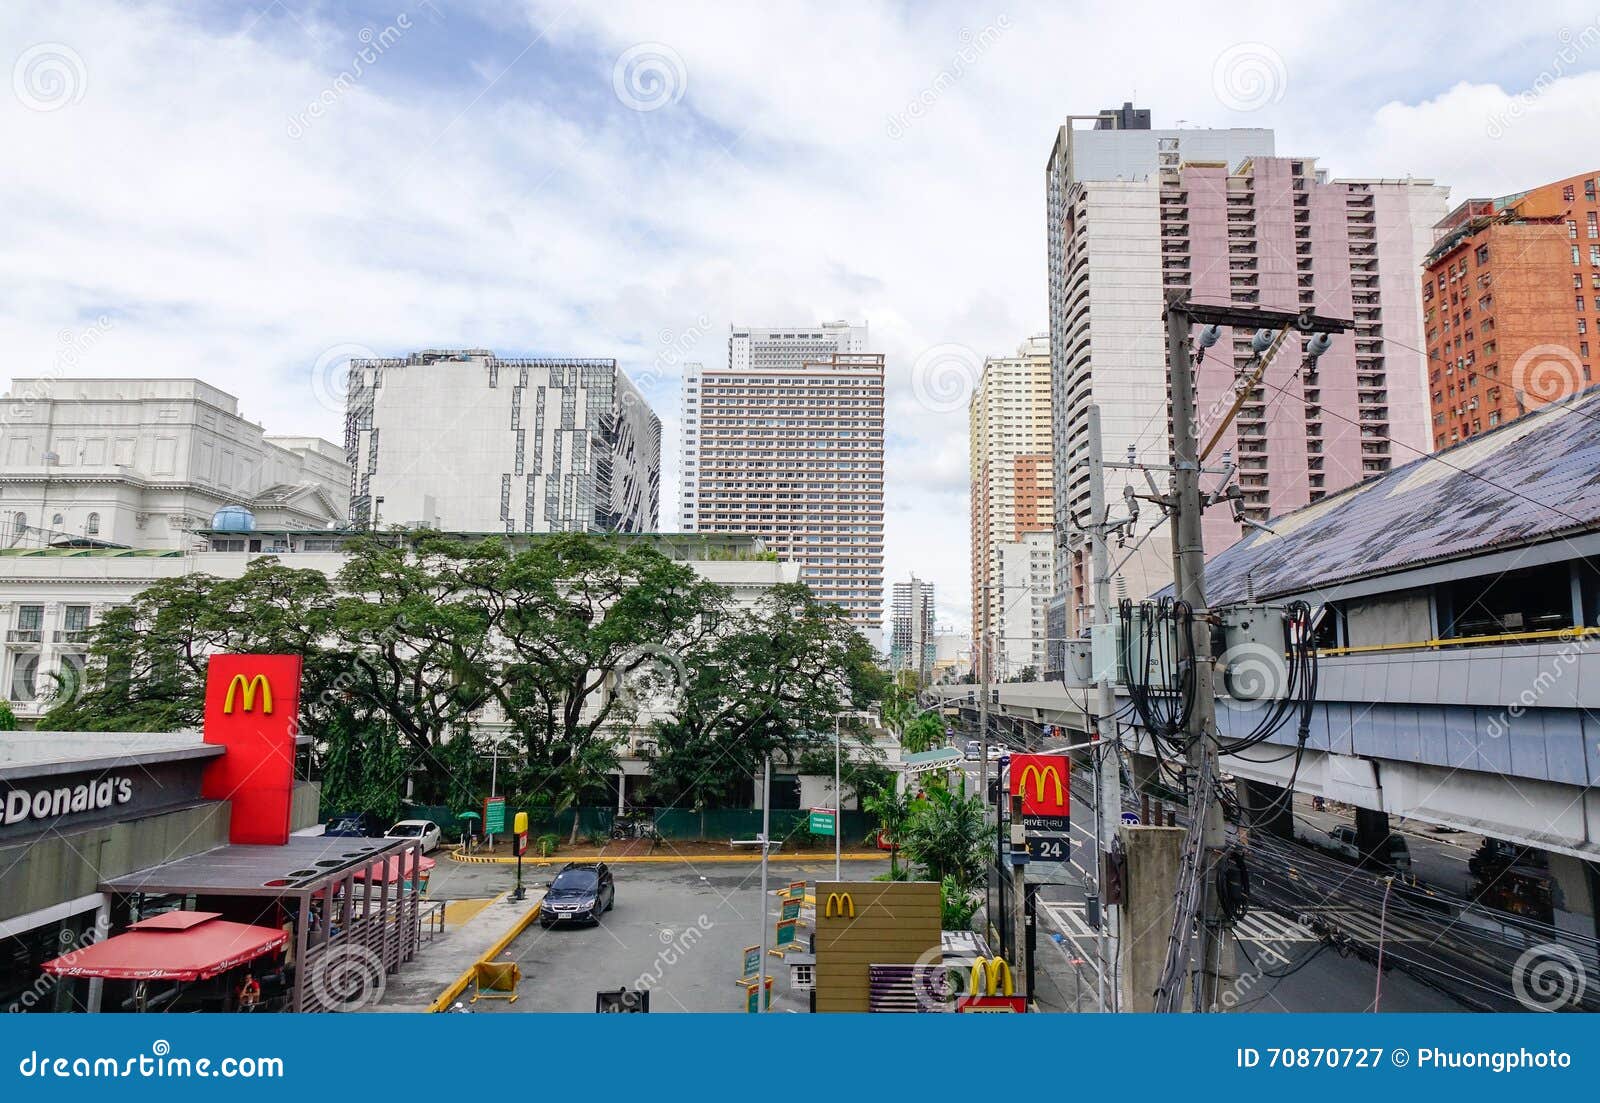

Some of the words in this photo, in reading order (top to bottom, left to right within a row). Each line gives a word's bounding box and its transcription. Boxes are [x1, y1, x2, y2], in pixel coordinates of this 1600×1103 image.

[1024, 818, 1063, 827] RIVETHRU
[1040, 842, 1062, 857] 24
[68, 967, 82, 976] 24
[148, 969, 162, 978] 24
